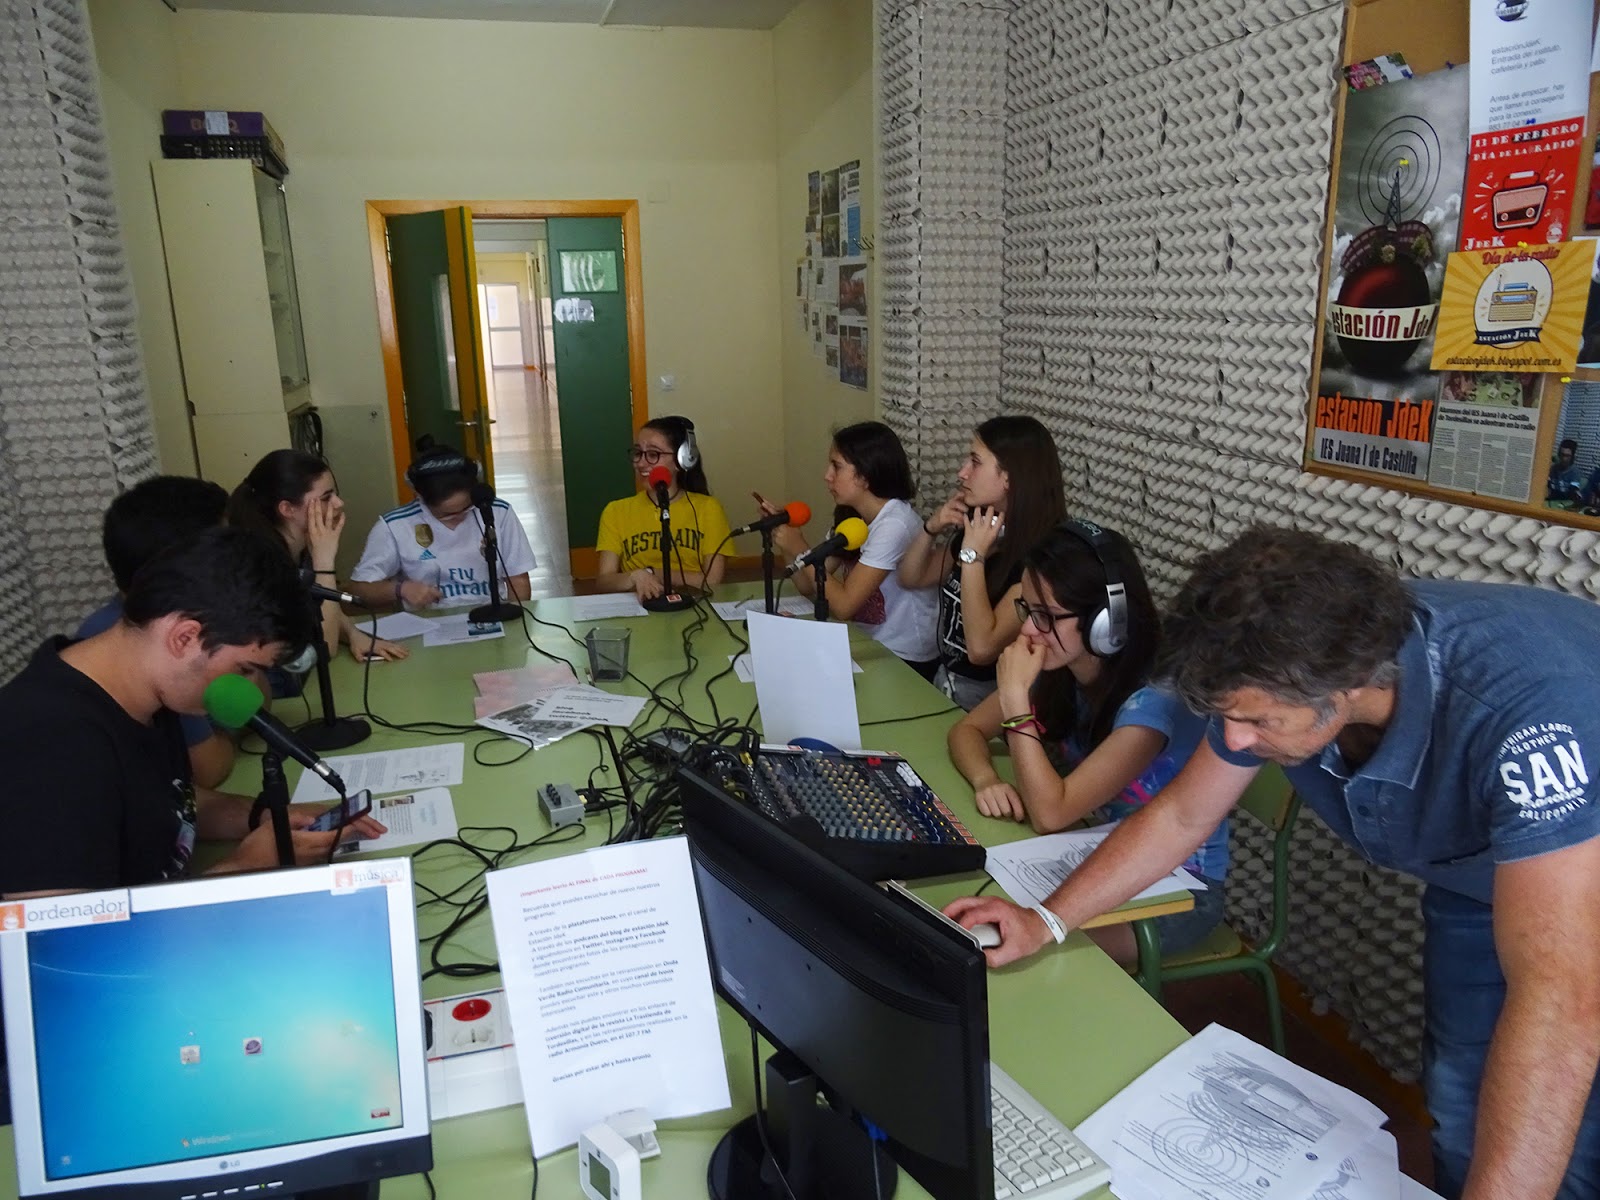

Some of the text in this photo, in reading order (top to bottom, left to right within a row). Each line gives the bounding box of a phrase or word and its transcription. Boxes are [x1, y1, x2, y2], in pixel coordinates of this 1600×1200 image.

[1489, 93, 1510, 103] Antes
[1491, 135, 1509, 145] DE
[1513, 123, 1580, 143] FEBRERO
[1499, 150, 1512, 158] DE
[1514, 147, 1528, 156] LA
[1534, 139, 1575, 153] RADIO
[1483, 251, 1501, 265] Día
[1504, 250, 1517, 263] de
[1331, 307, 1401, 338] estación
[1316, 391, 1433, 443] estación JdeK
[1520, 423, 1536, 431] radio
[1321, 437, 1418, 475] IES Juana I de Castilla
[448, 567, 474, 581] Fly
[1510, 732, 1558, 755] CLOTHES
[1499, 739, 1589, 804] SAN
[1518, 796, 1588, 821] CALIFORNIA
[27, 899, 126, 922] ordenador
[567, 916, 599, 929] plataforma
